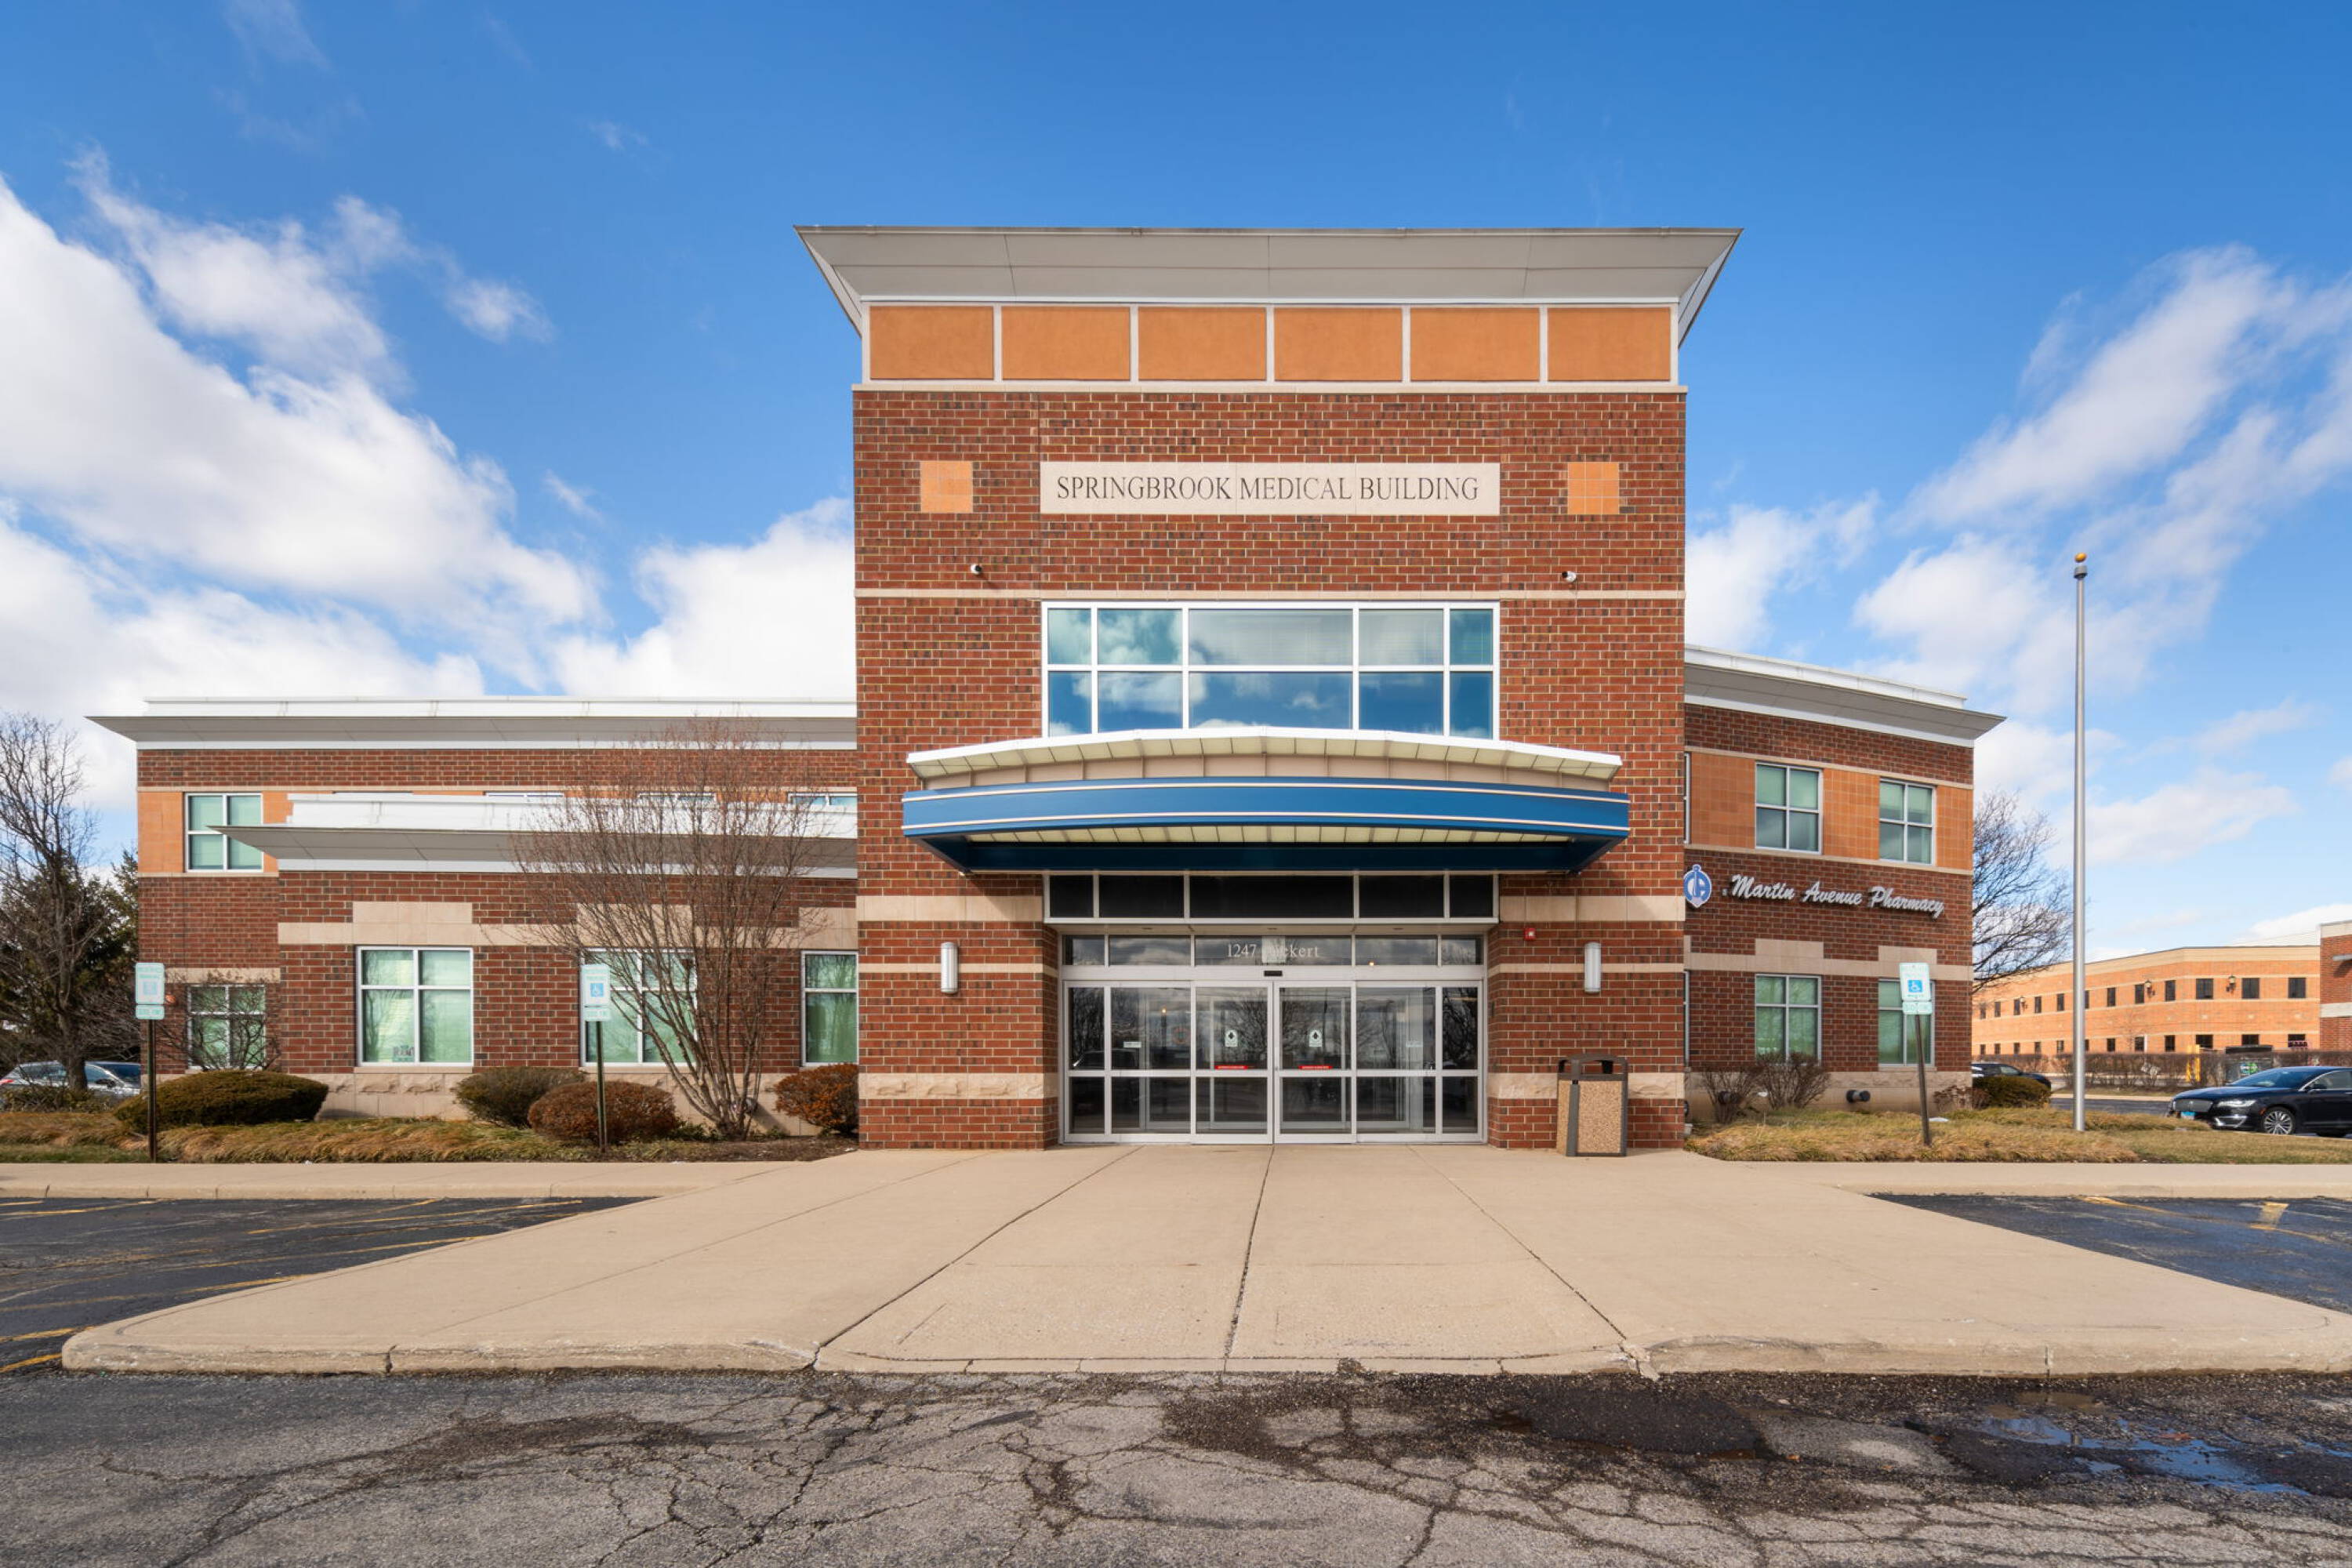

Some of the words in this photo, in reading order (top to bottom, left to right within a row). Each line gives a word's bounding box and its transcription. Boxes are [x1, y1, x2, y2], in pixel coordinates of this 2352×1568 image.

[1058, 475, 1232, 500] SPRINGBROOK
[1240, 475, 1352, 500] MEDICAL
[1359, 475, 1479, 500] BUILDING
[1731, 873, 1795, 901] Martin
[1802, 880, 1863, 906] Avenue
[1868, 886, 1944, 919] Pharmacy
[1227, 943, 1257, 957] 1247
